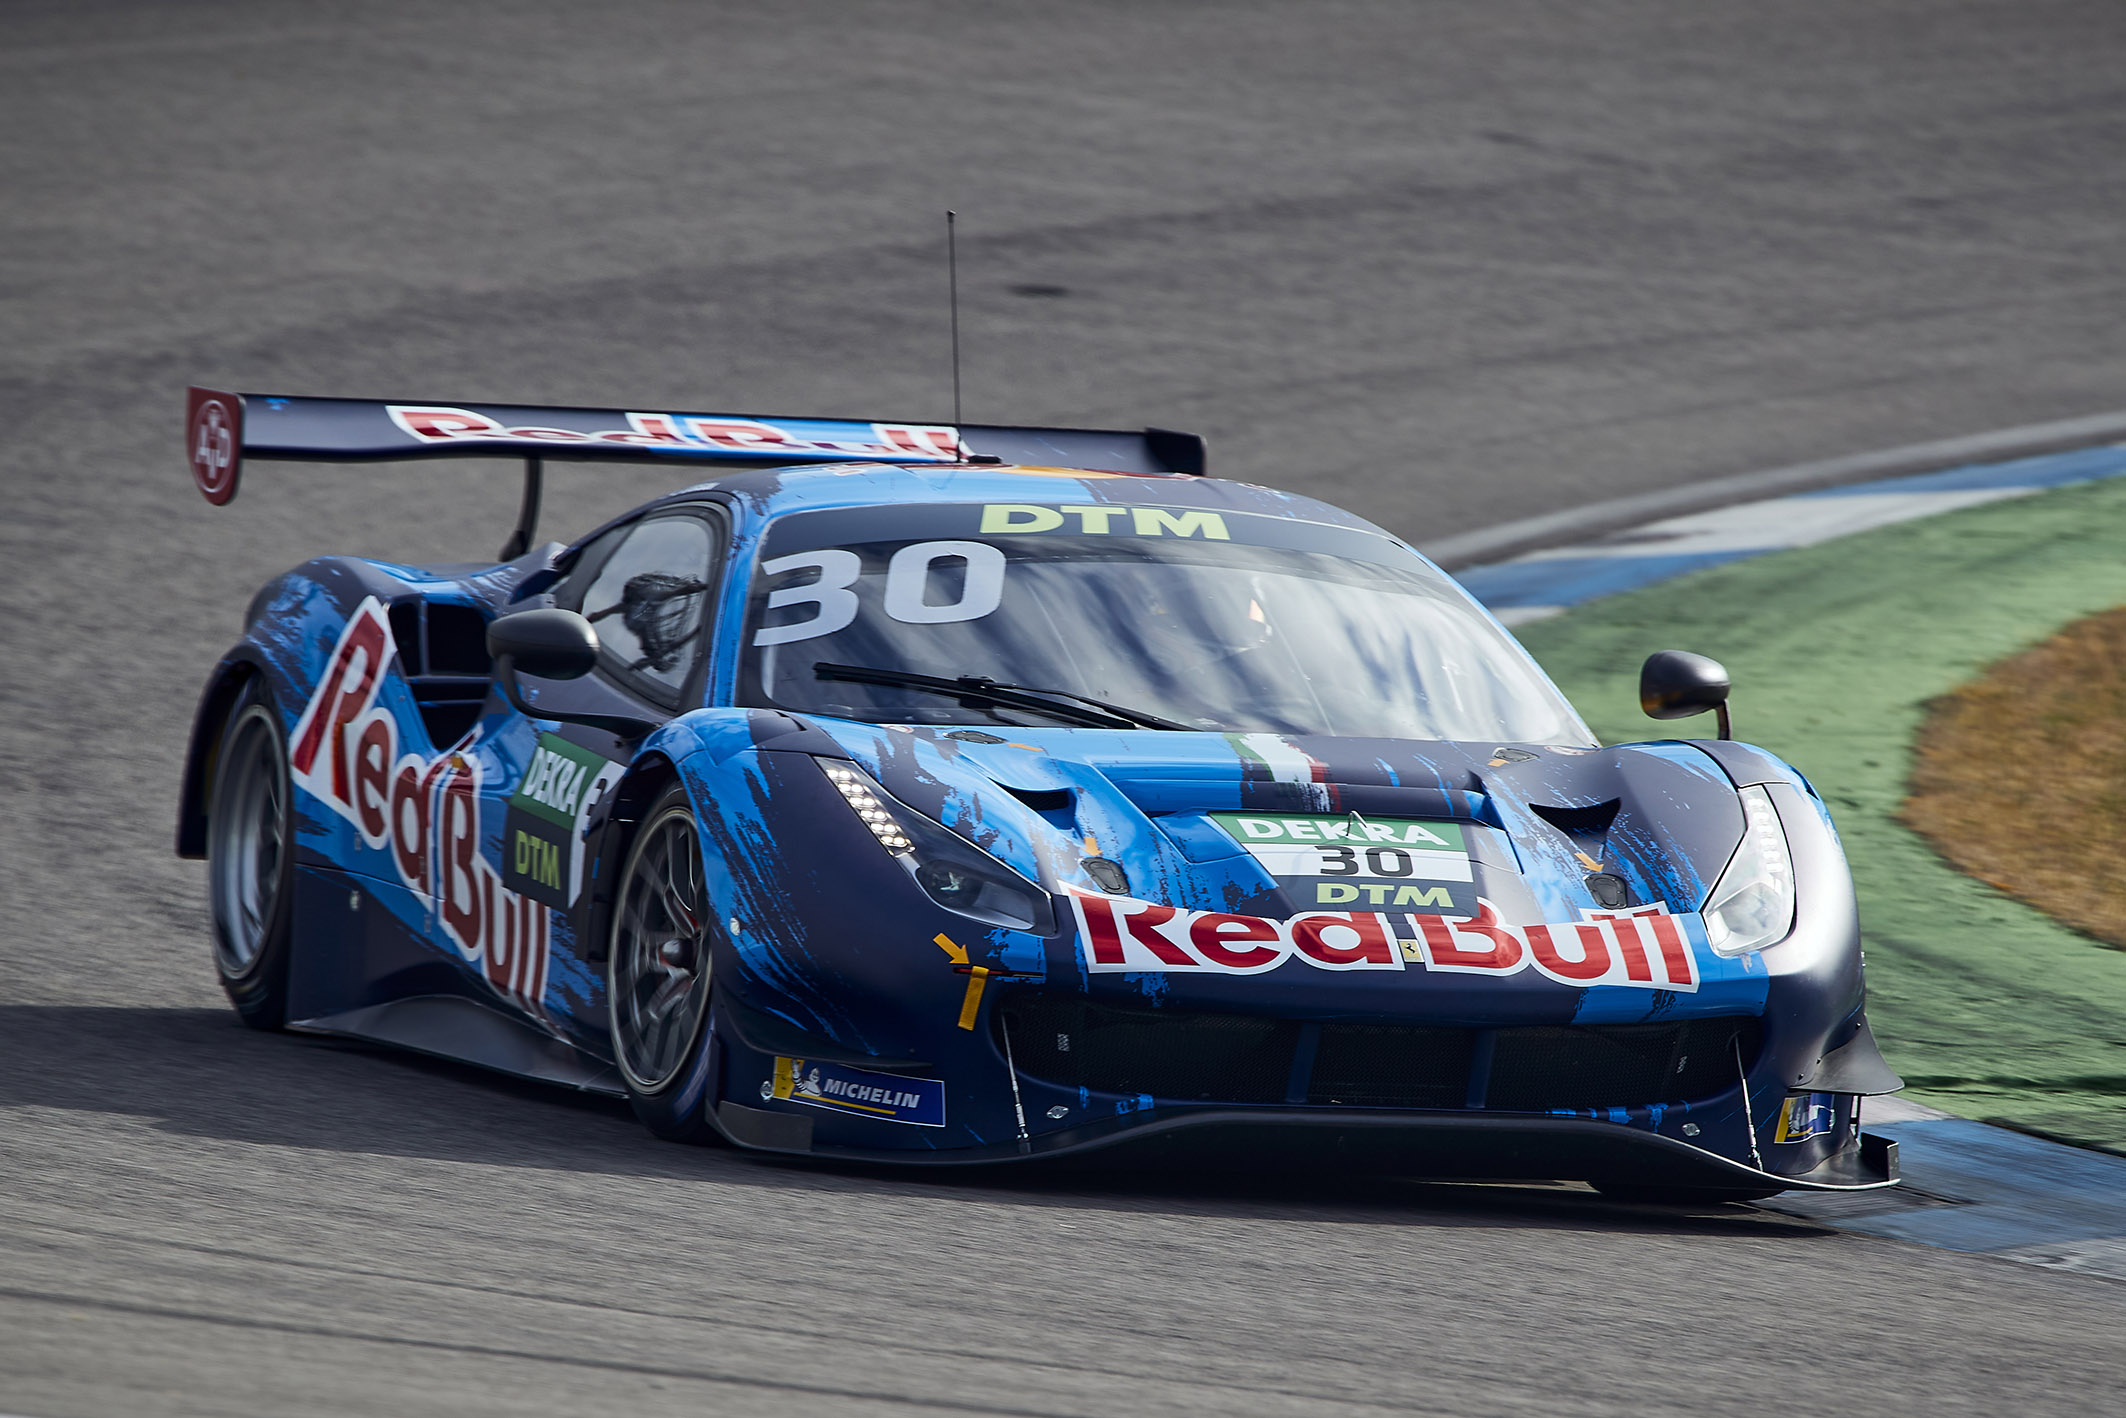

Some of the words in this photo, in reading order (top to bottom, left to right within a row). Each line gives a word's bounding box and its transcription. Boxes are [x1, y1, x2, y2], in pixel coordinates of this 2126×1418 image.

[979, 504, 1231, 541] DTM
[752, 540, 1008, 647] 30
[521, 746, 588, 816] DEKRA
[289, 604, 482, 899] Red
[441, 762, 549, 1013] Bull
[1236, 818, 1450, 847] DEKRA
[514, 829, 560, 890] DTM
[1314, 845, 1414, 877] 30
[1316, 883, 1455, 908] DTM
[1066, 885, 1398, 970] Red
[1411, 902, 1694, 986] Bull
[823, 1078, 921, 1109] MICHELIN
